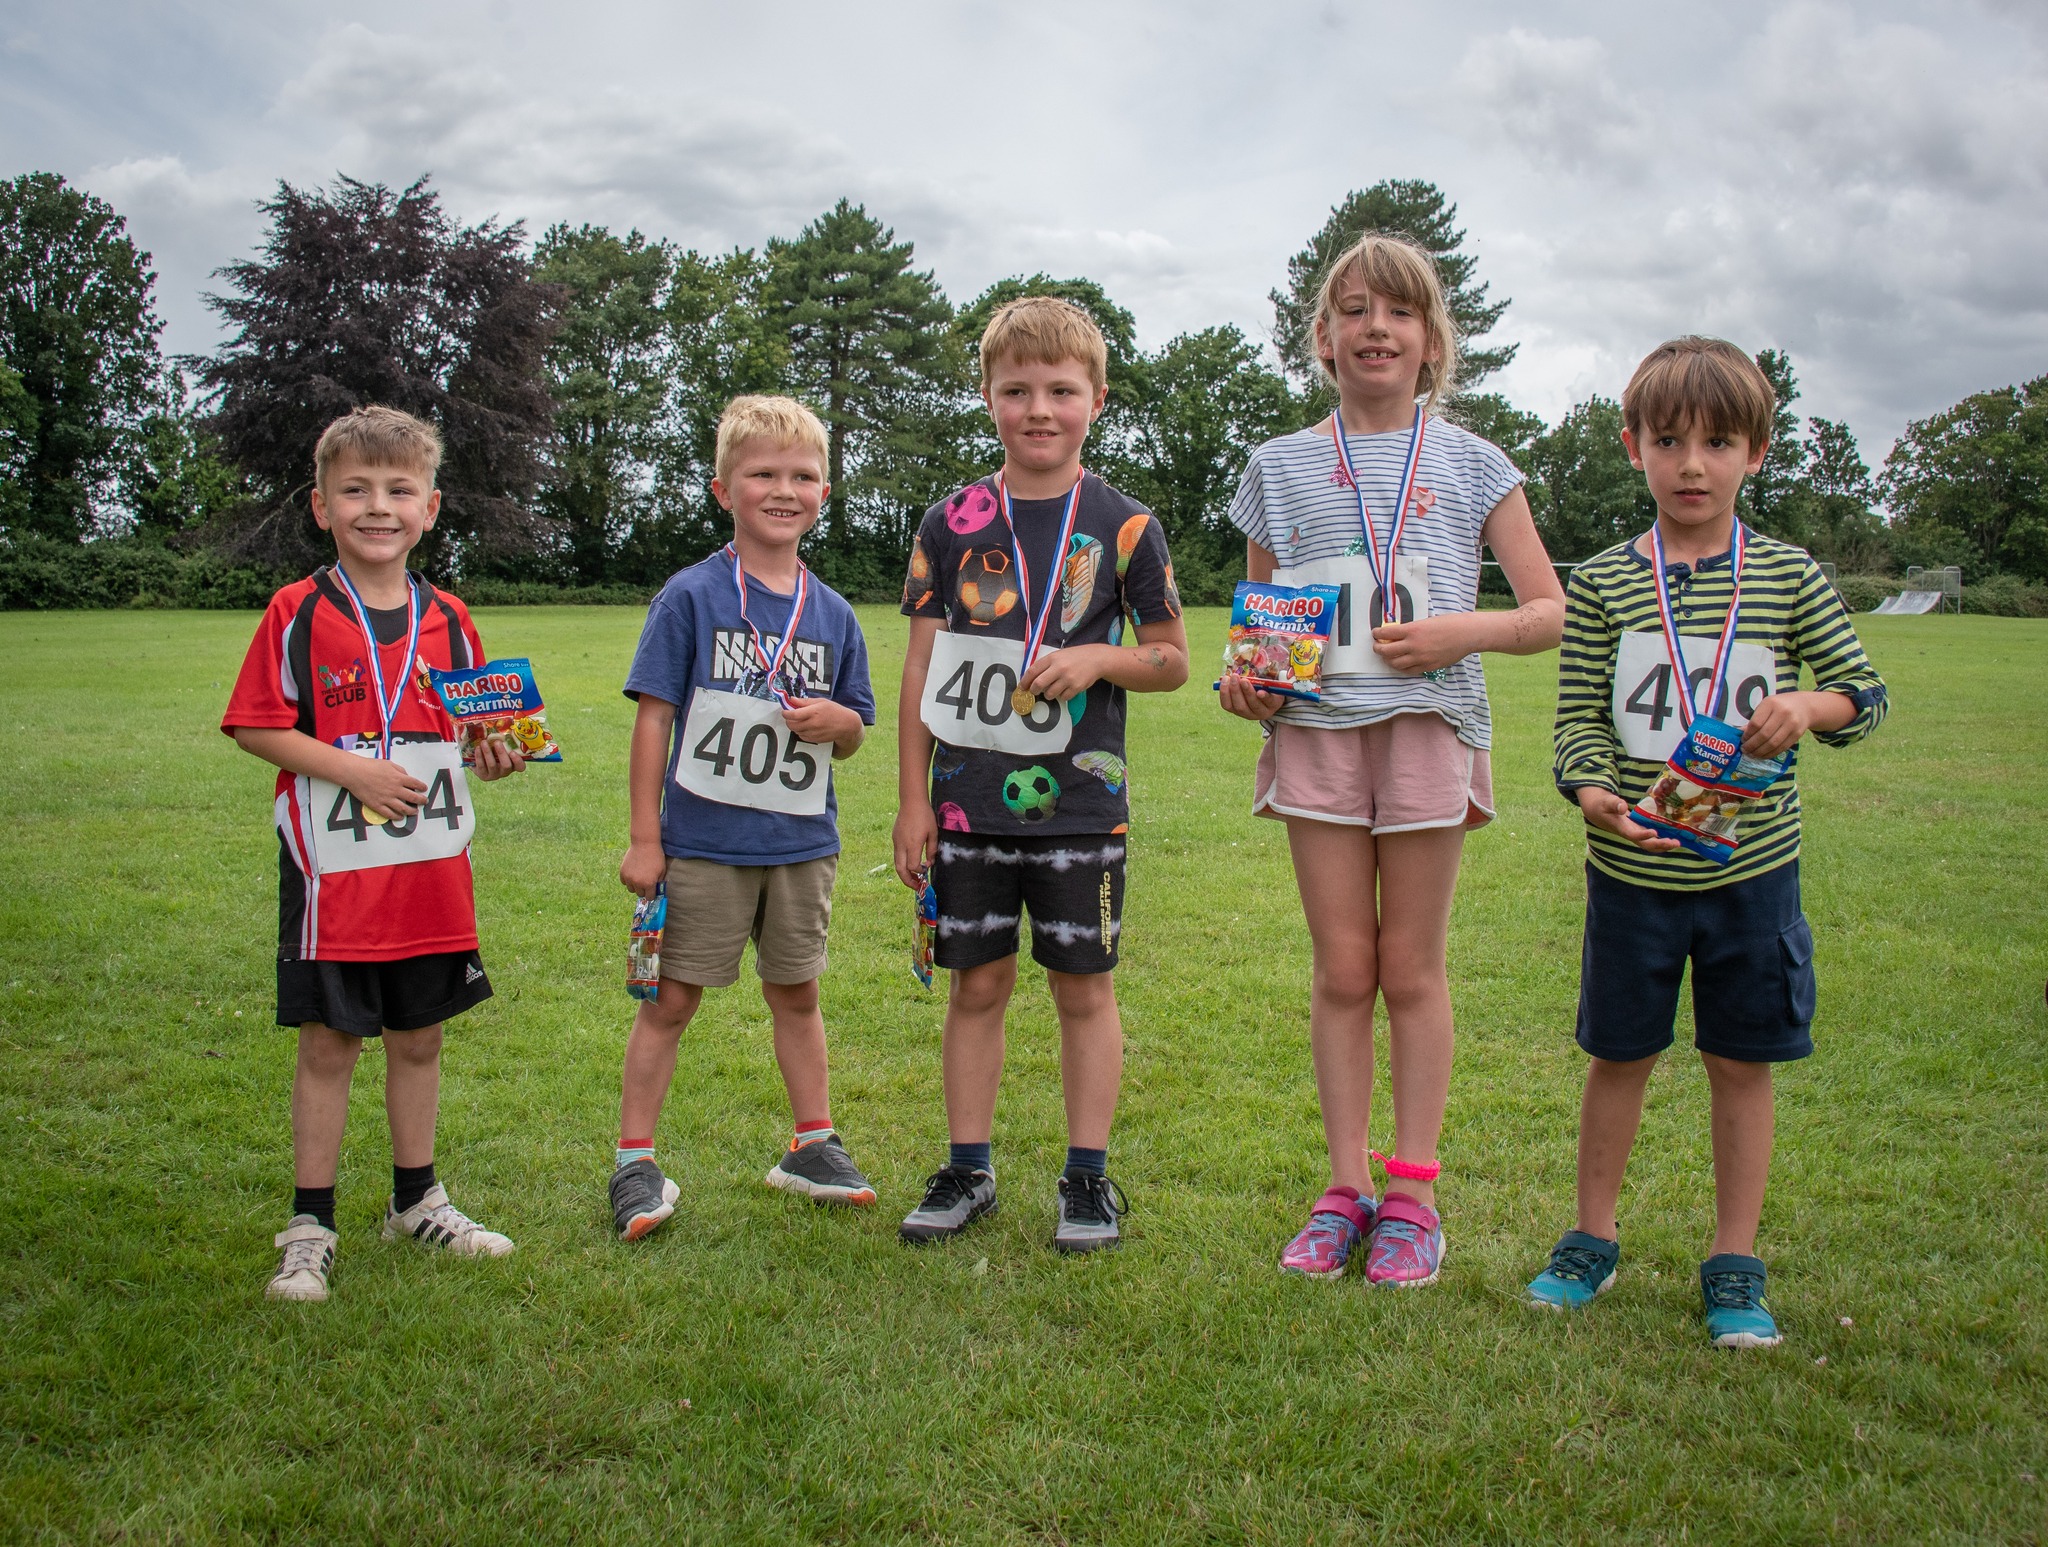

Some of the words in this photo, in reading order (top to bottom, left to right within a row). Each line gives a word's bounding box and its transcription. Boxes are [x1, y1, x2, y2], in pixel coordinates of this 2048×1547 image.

[1243, 592, 1325, 618] HARIBO
[1248, 612, 1312, 633] Starmix
[324, 687, 367, 709] CLUB
[444, 673, 524, 700] HARIBO
[457, 695, 521, 715] Starmix
[692, 716, 818, 792] 405
[1693, 730, 1736, 756] HARIBO
[1693, 745, 1729, 766] Starmix
[1103, 871, 1112, 955] CALIFORNIA
